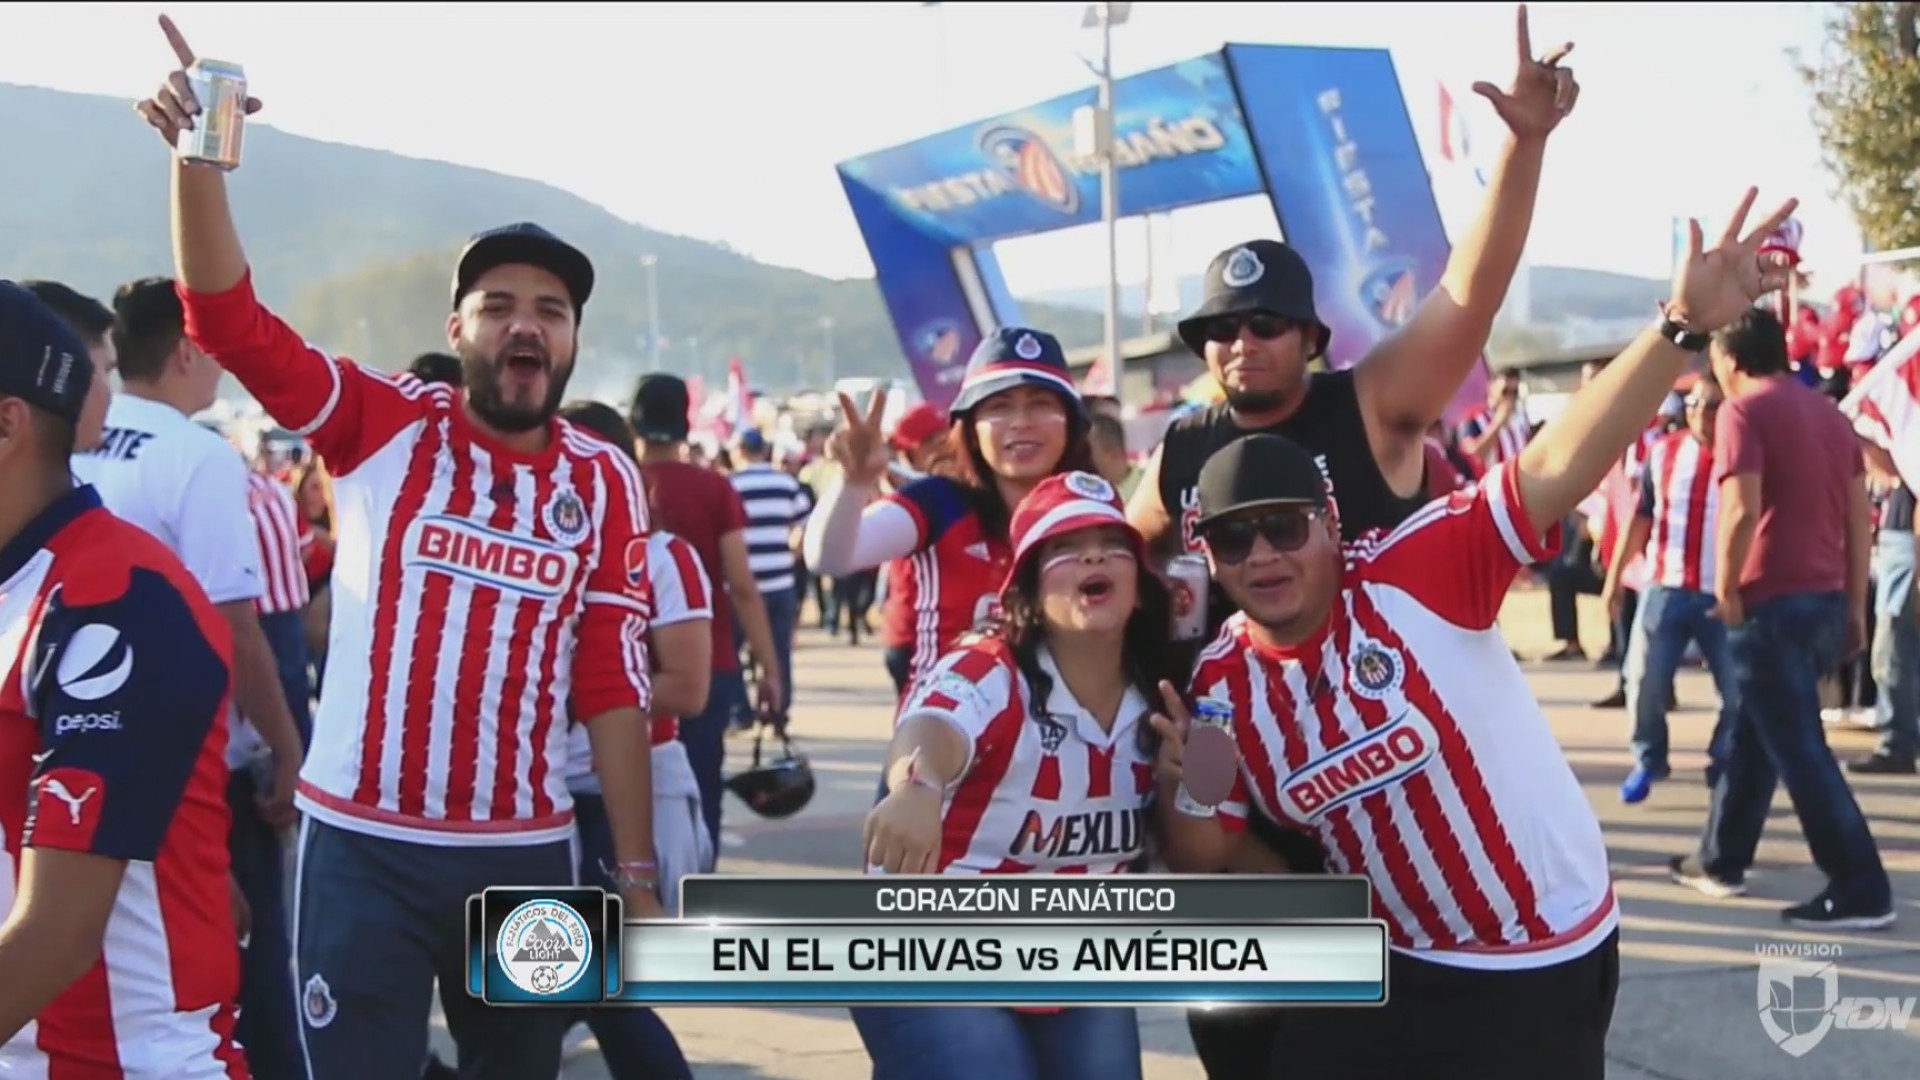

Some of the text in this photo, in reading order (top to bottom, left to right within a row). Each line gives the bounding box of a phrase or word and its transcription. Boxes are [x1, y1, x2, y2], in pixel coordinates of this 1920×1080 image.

[95, 427, 157, 461] ATE
[416, 523, 566, 587] BIMBO
[55, 711, 120, 736] pepsi
[1287, 725, 1425, 815] BIMBO
[1008, 808, 1144, 859] MEXLU
